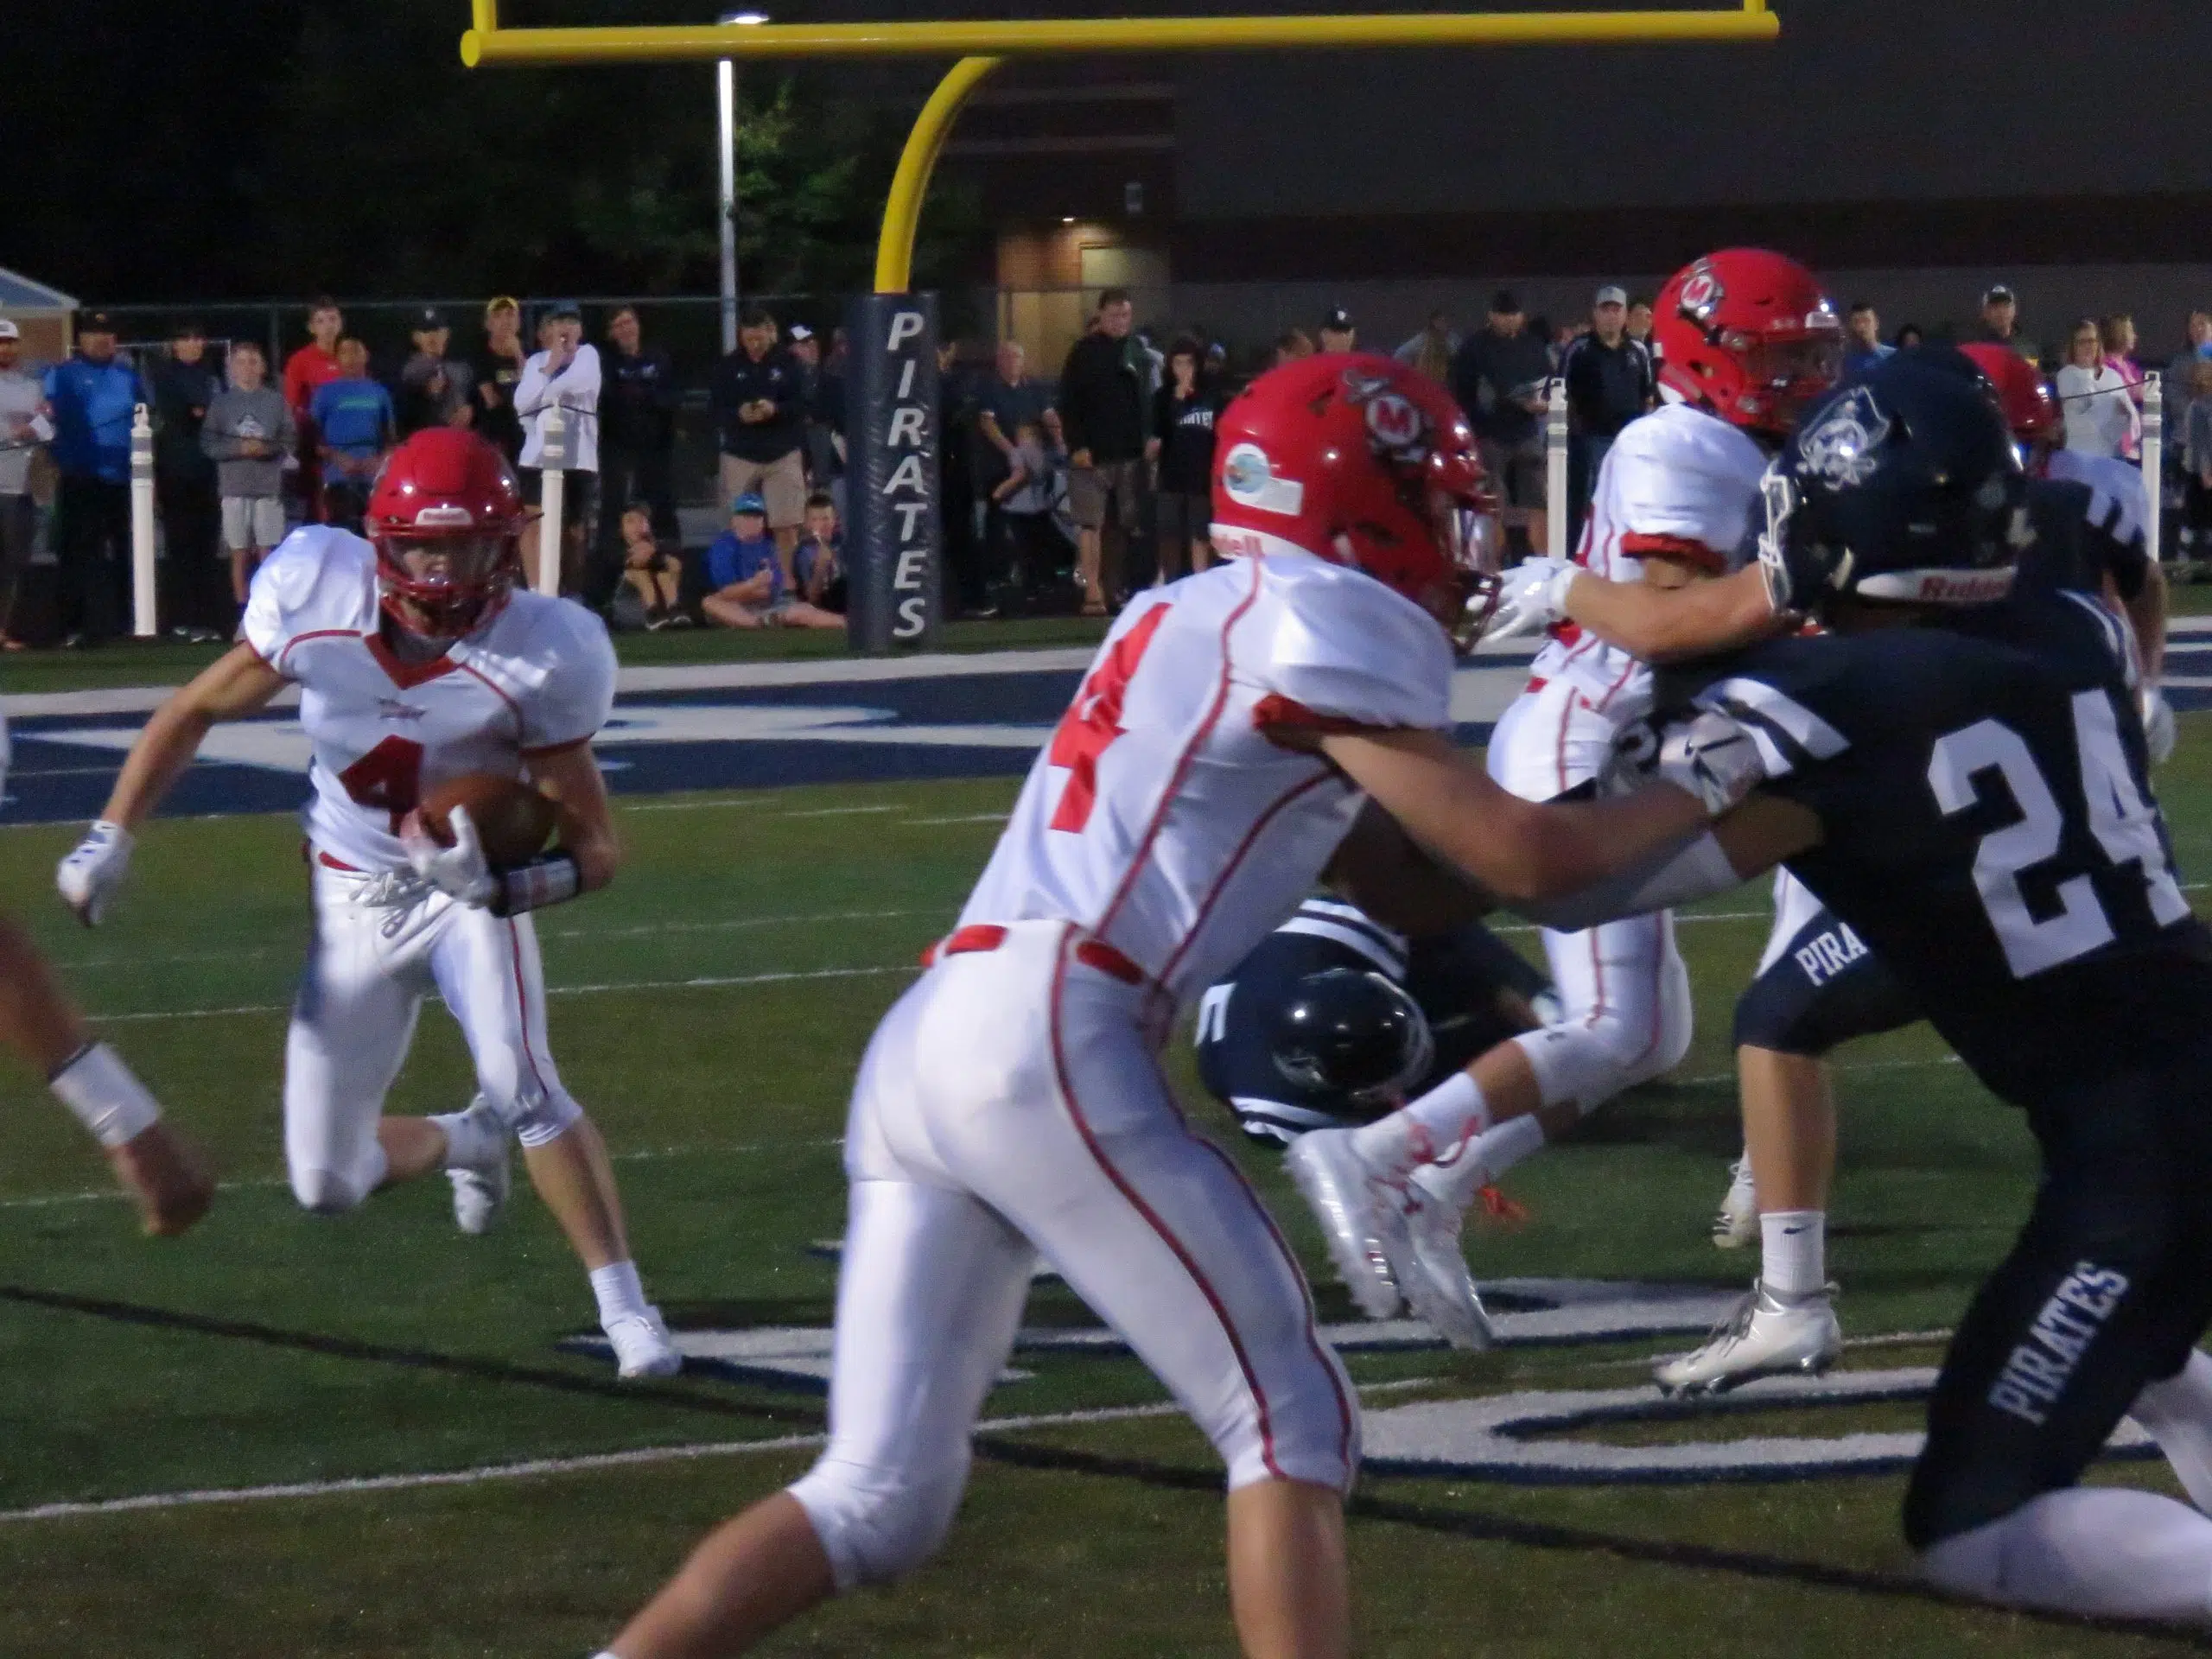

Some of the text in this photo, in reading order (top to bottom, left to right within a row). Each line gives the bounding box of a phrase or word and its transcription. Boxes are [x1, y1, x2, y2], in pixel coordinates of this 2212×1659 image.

[881, 311, 929, 638] PIRATES
[1375, 392, 1415, 435] M
[338, 733, 425, 838] 4
[1928, 689, 2192, 980] 24
[1986, 1260, 2130, 1427] PIRATES
